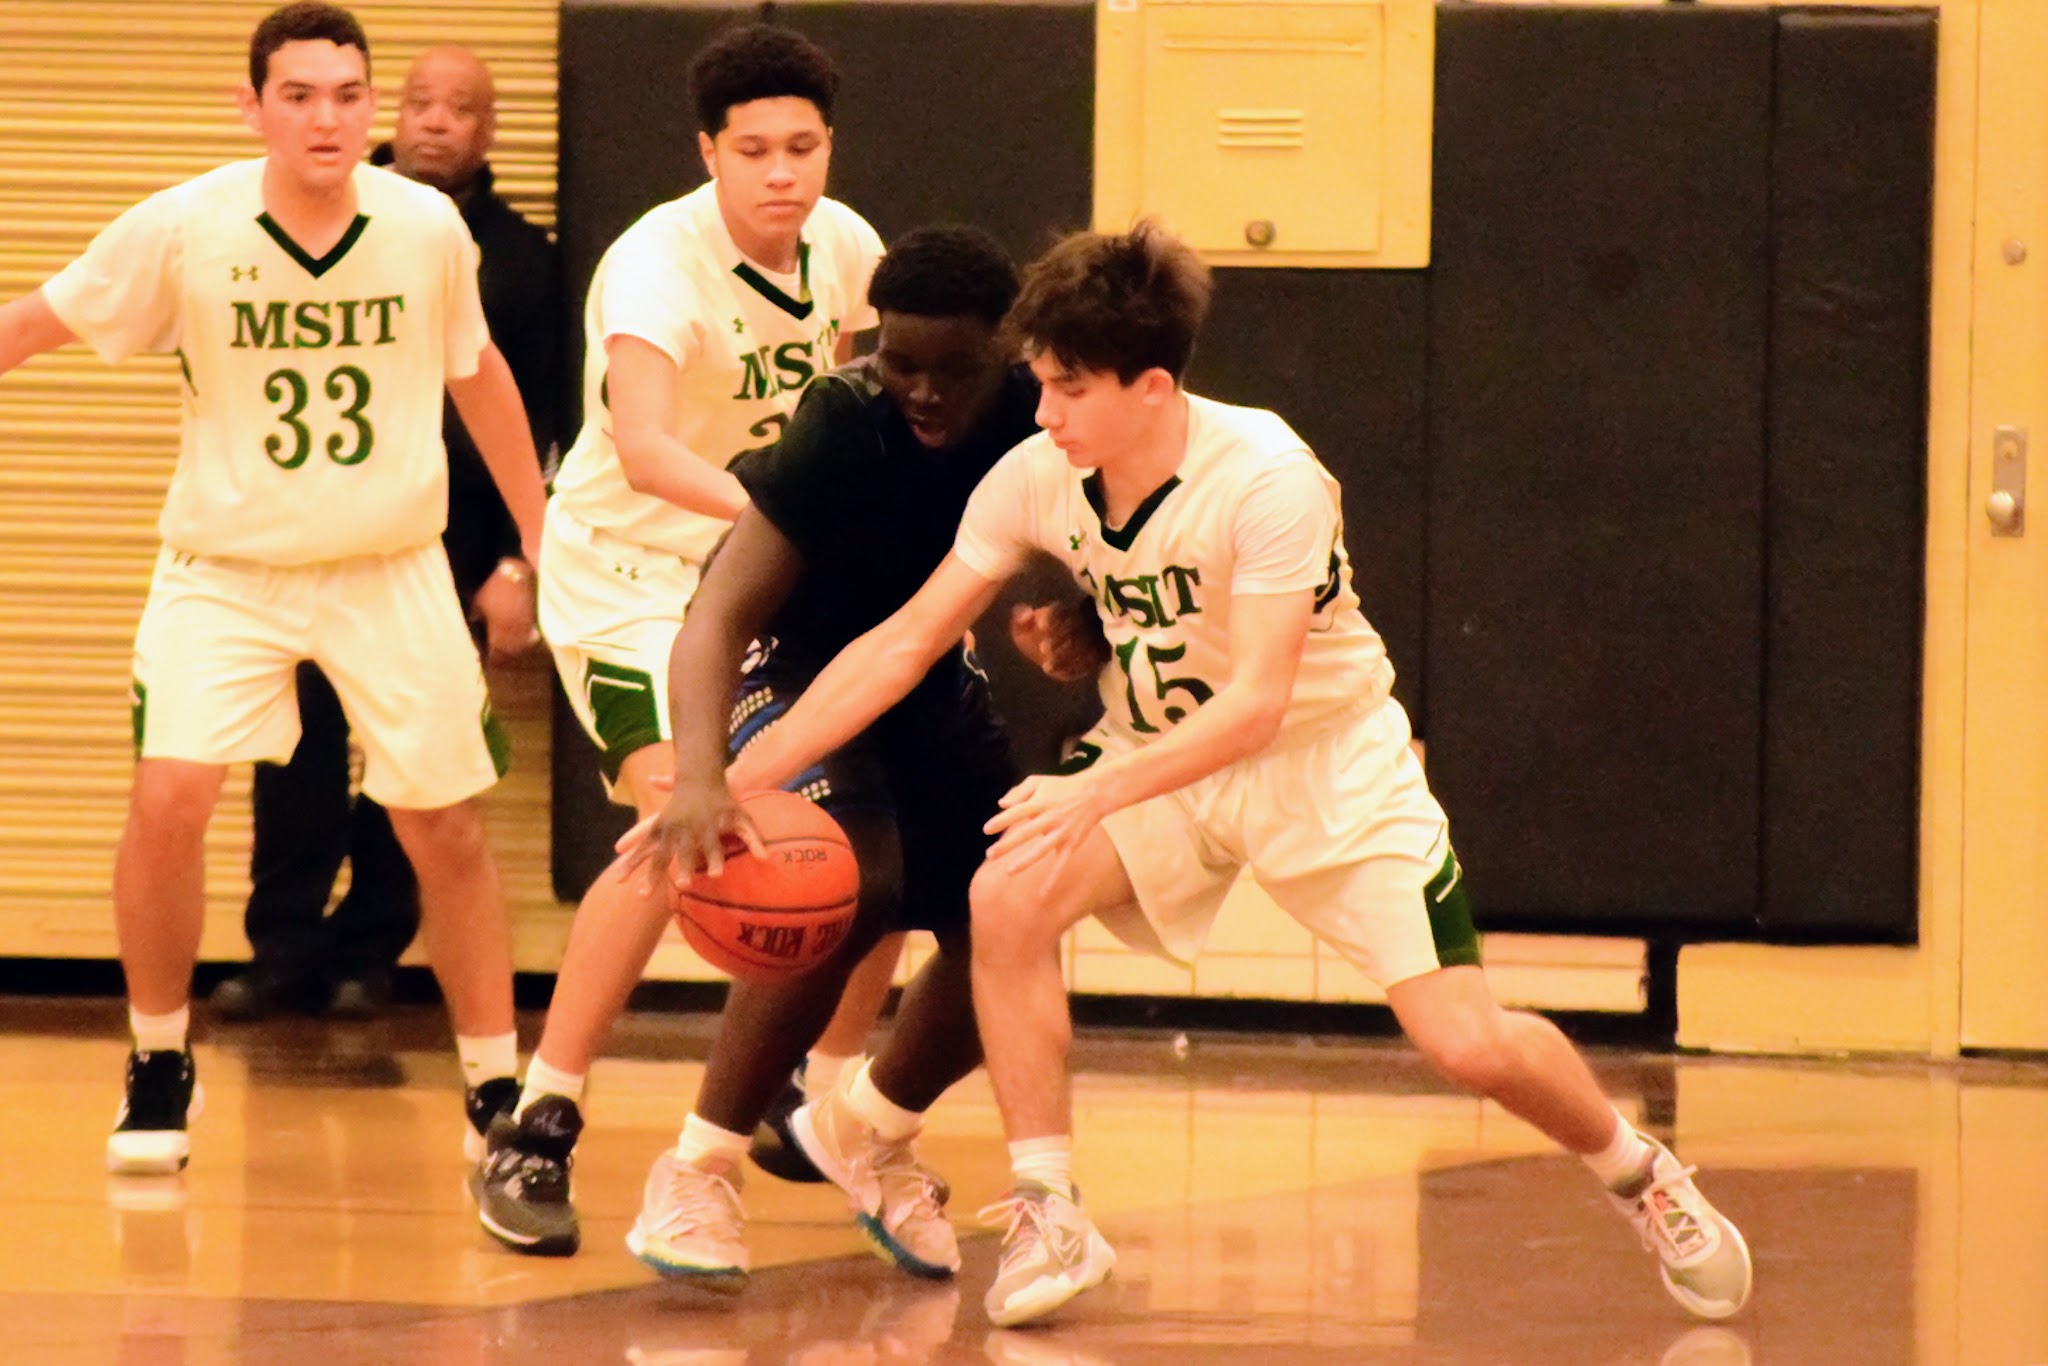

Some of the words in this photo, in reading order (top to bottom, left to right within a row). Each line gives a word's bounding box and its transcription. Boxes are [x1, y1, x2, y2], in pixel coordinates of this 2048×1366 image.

[230, 294, 405, 349] MSIT
[264, 364, 375, 470] 33
[1115, 635, 1216, 734] 15
[783, 848, 828, 864] ROCK
